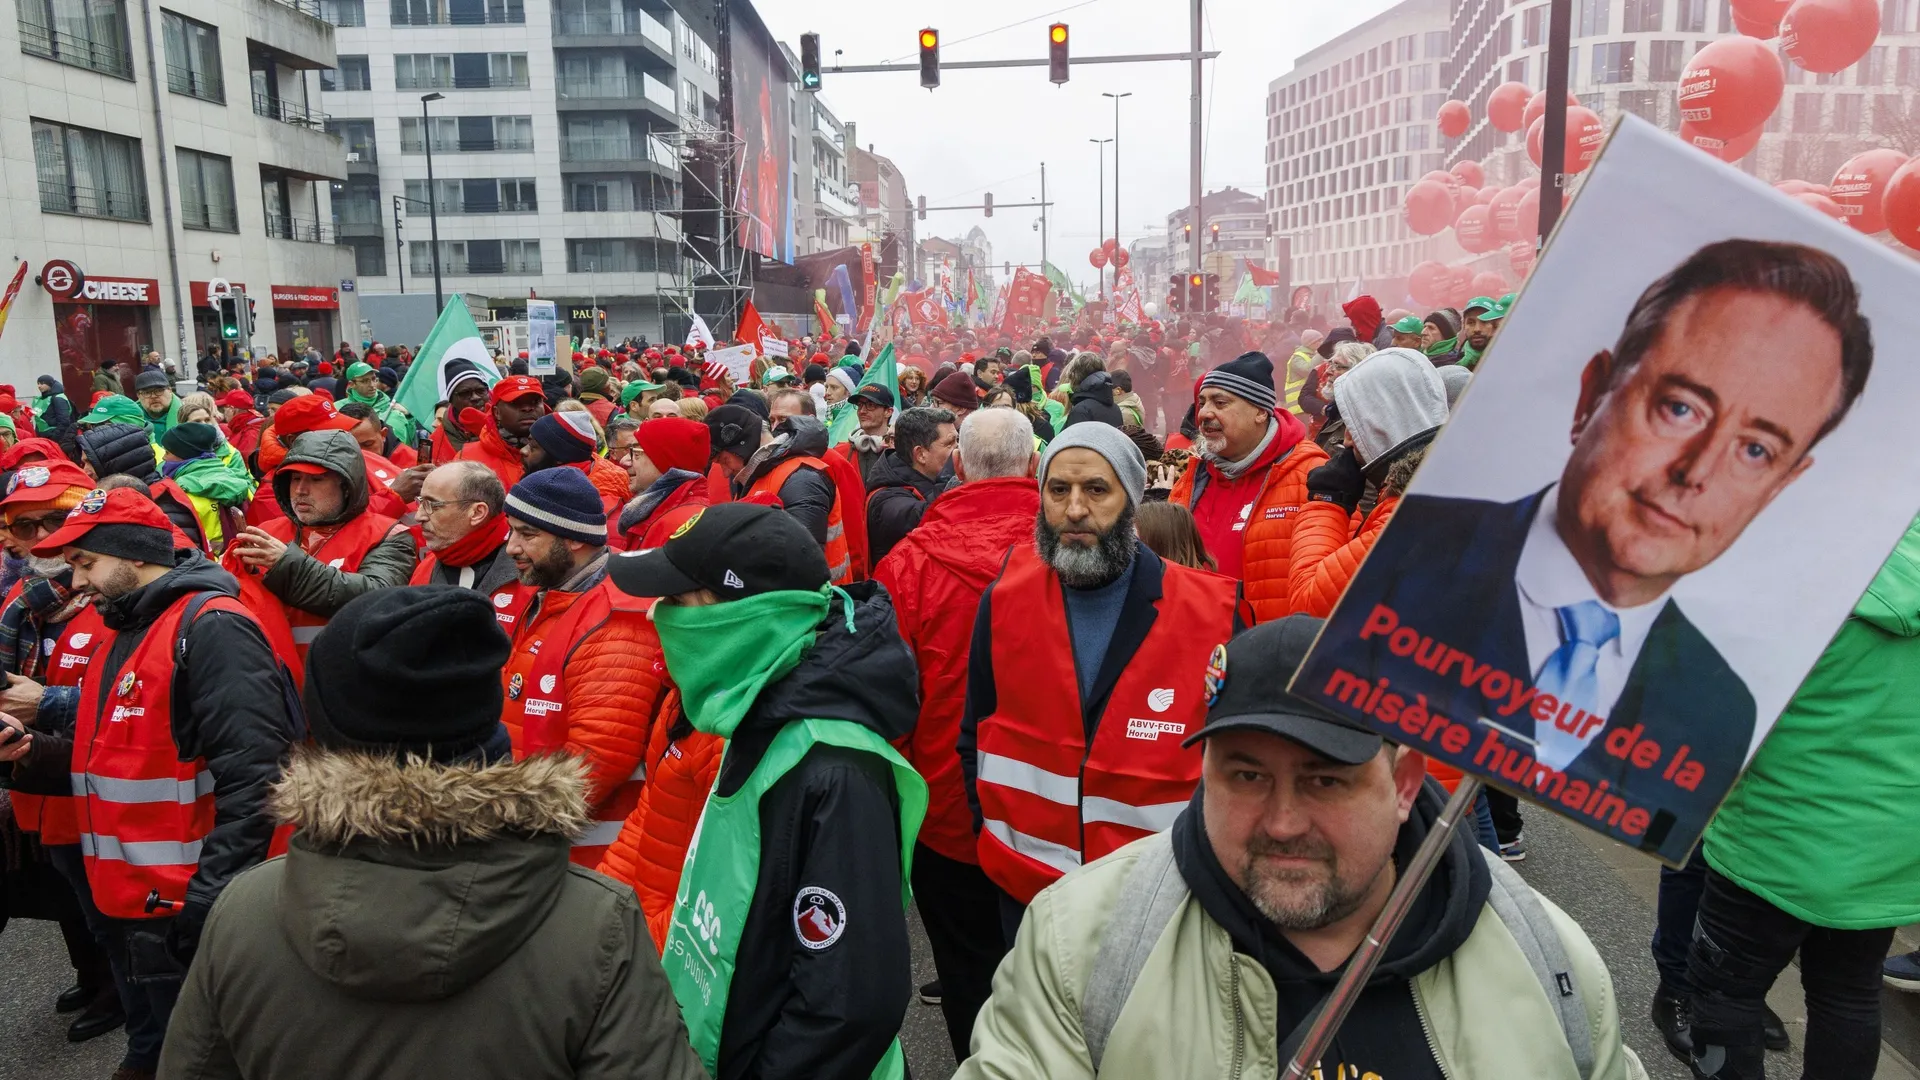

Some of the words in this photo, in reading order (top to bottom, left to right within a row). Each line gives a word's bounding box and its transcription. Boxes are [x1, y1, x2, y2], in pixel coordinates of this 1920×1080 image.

[78, 280, 149, 301] CHEESE
[572, 309, 594, 319] PAU
[527, 699, 561, 710] ABVV-FGTB
[1359, 603, 1604, 741] Pourvoyeur
[1604, 723, 1662, 770] de
[1661, 744, 1706, 792] la
[526, 707, 546, 715] Horval
[1129, 719, 1183, 733] ABVV-FGTB
[1128, 729, 1157, 739] Horval
[1323, 668, 1475, 755] misère
[1473, 728, 1652, 837] humaine
[684, 951, 713, 1006] publics
